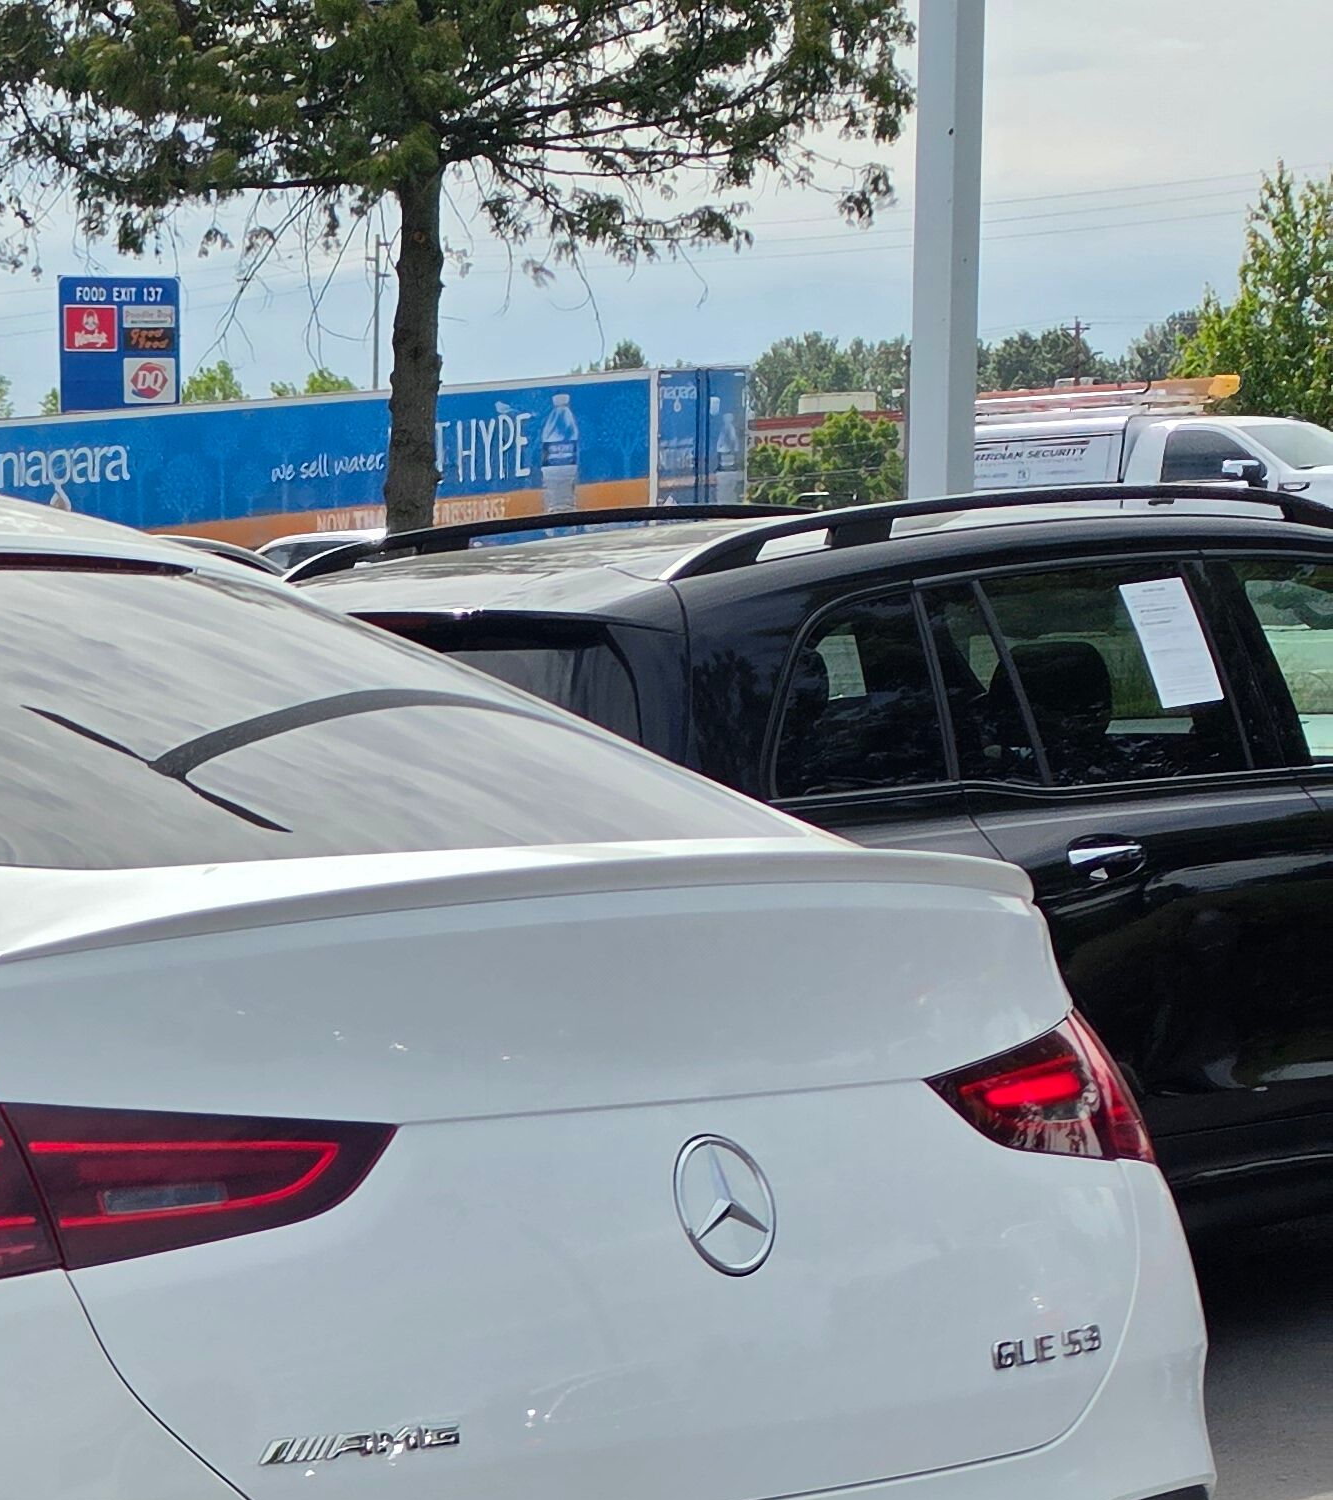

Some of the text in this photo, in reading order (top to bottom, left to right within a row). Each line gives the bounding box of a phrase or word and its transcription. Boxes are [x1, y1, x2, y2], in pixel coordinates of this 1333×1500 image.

[76, 286, 163, 302] FOOD EXIT 137
[137, 370, 164, 392] DQ
[457, 412, 532, 483] HYPE
[1029, 447, 1087, 459] SECURITY
[272, 463, 295, 483] we
[299, 453, 329, 479] sell
[991, 1323, 1102, 1370] GLE 53
